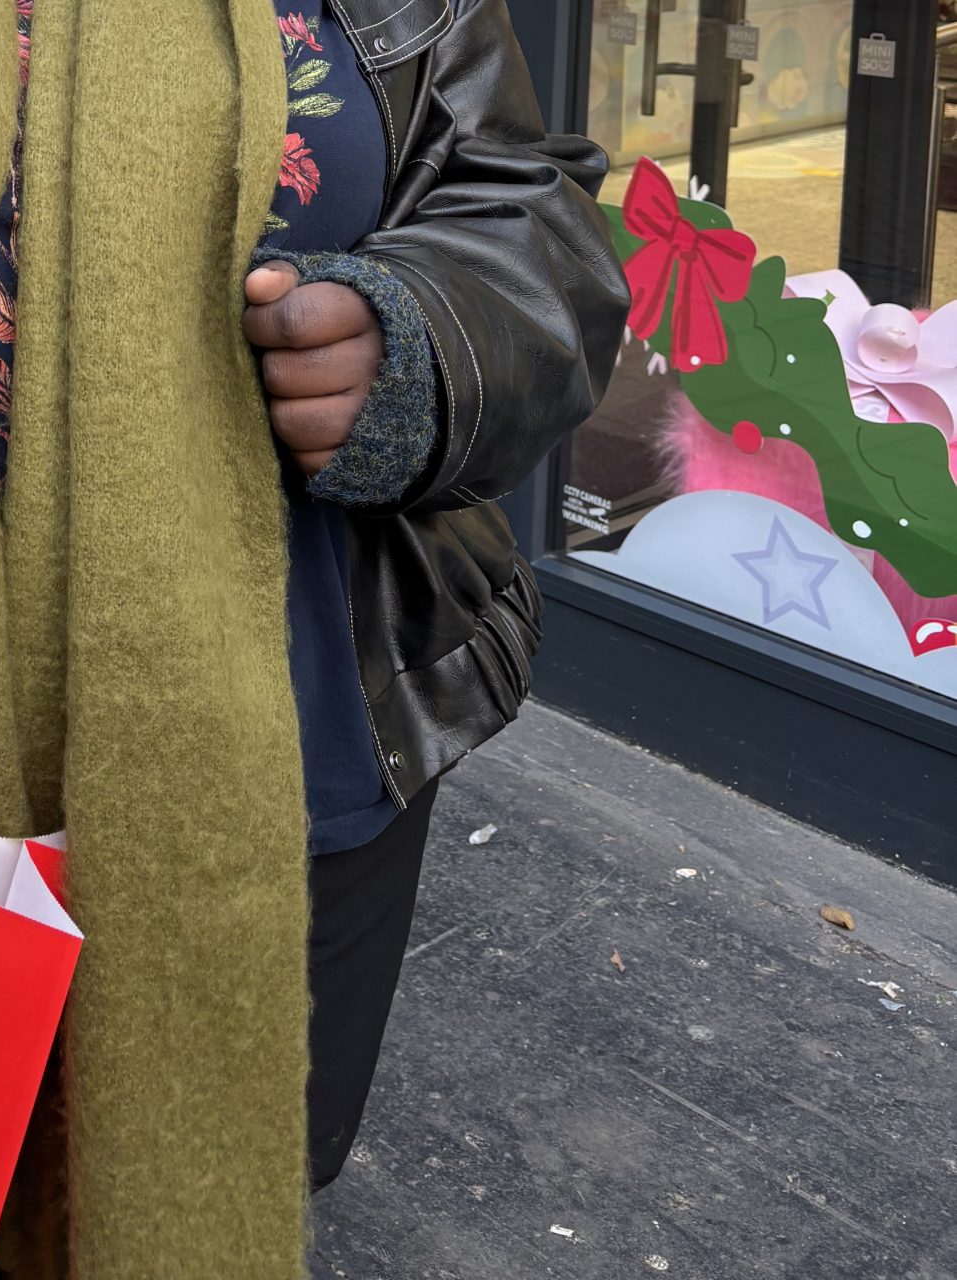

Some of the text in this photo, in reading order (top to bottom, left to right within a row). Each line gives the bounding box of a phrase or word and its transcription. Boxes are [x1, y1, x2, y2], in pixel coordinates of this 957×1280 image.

[729, 30, 757, 43] MINI
[861, 44, 892, 57] MINI
[580, 490, 612, 510] CAMERAS
[561, 508, 610, 536] WARNING
